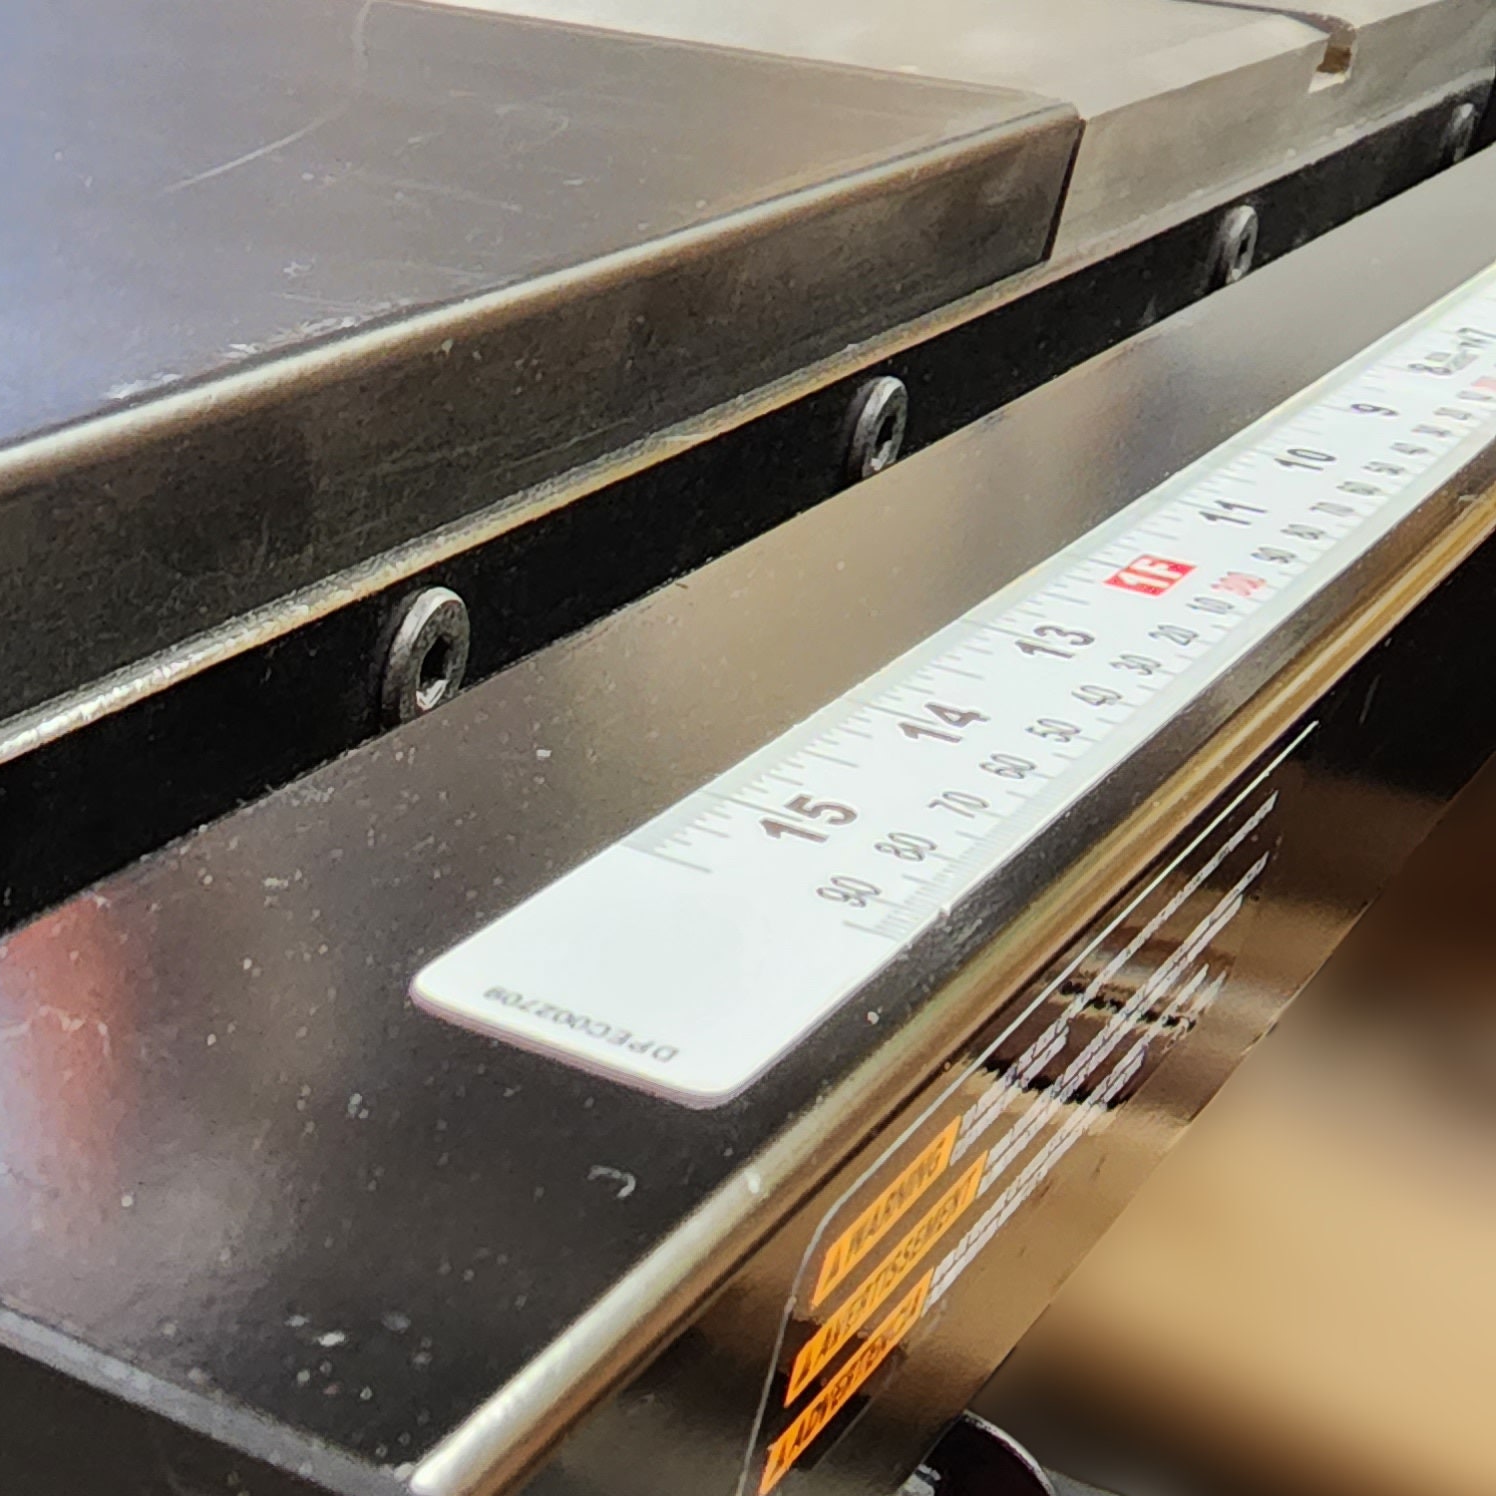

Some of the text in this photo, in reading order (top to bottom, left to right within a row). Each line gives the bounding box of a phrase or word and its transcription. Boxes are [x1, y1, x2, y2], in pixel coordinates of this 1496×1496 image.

[1350, 403, 1398, 416] 9
[1273, 448, 1337, 471] 10
[1198, 499, 1269, 526] 11
[1015, 624, 1096, 660] 13
[1147, 624, 1200, 647] 20
[1109, 653, 1163, 676] 30
[1071, 684, 1124, 707] 40
[897, 702, 992, 744] 14
[1024, 717, 1082, 743] 50
[978, 752, 1038, 780] 60
[928, 790, 990, 819] 70
[759, 794, 859, 845] 15
[874, 832, 938, 862] 80
[816, 876, 881, 909] 90
